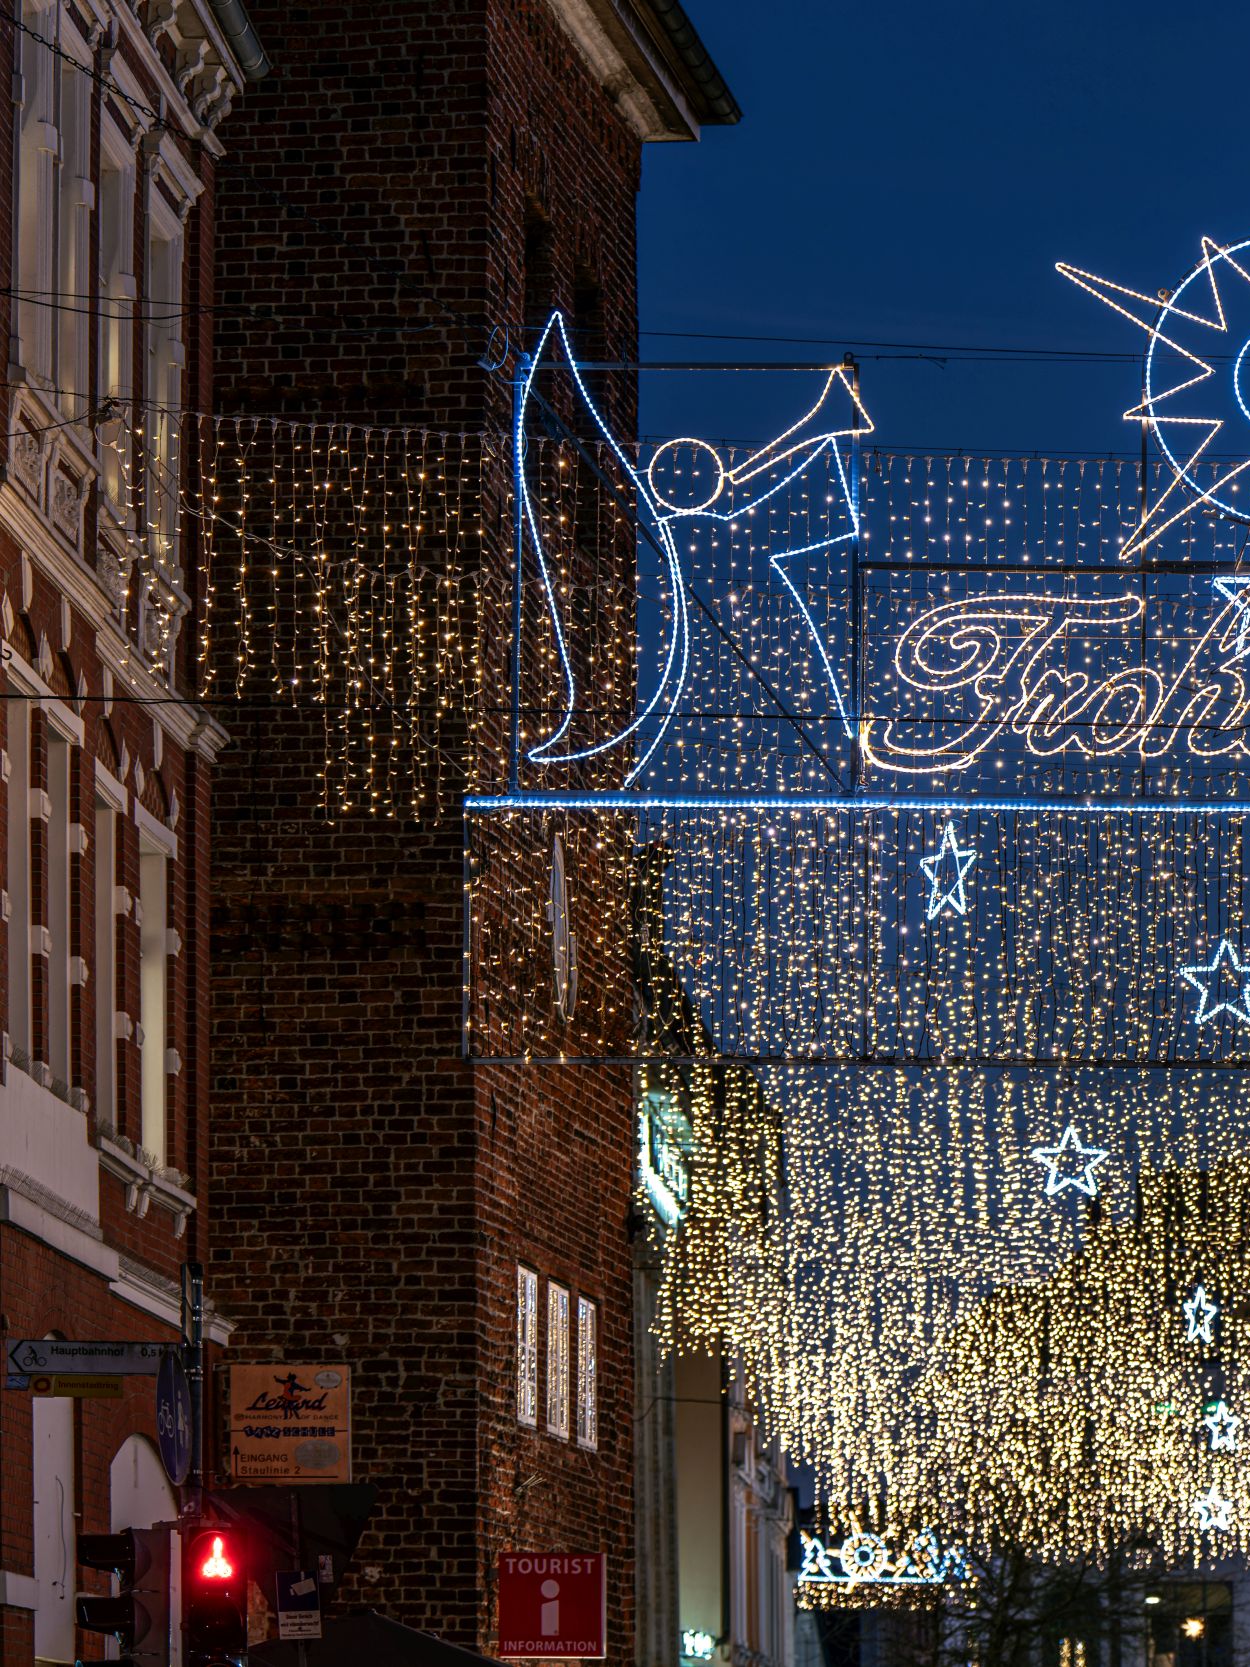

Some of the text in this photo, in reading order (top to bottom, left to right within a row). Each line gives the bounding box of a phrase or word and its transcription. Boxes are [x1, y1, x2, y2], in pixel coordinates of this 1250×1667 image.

[50, 1345, 125, 1358] Hauptbahnhof
[141, 1347, 156, 1358] 0,5
[243, 1425, 336, 1439] TANZ SCHULE
[240, 1454, 288, 1463] EINGANG
[240, 1465, 301, 1475] Staulinie 2
[505, 1558, 595, 1574] TOURIST
[503, 1640, 597, 1651] INFORMATION
